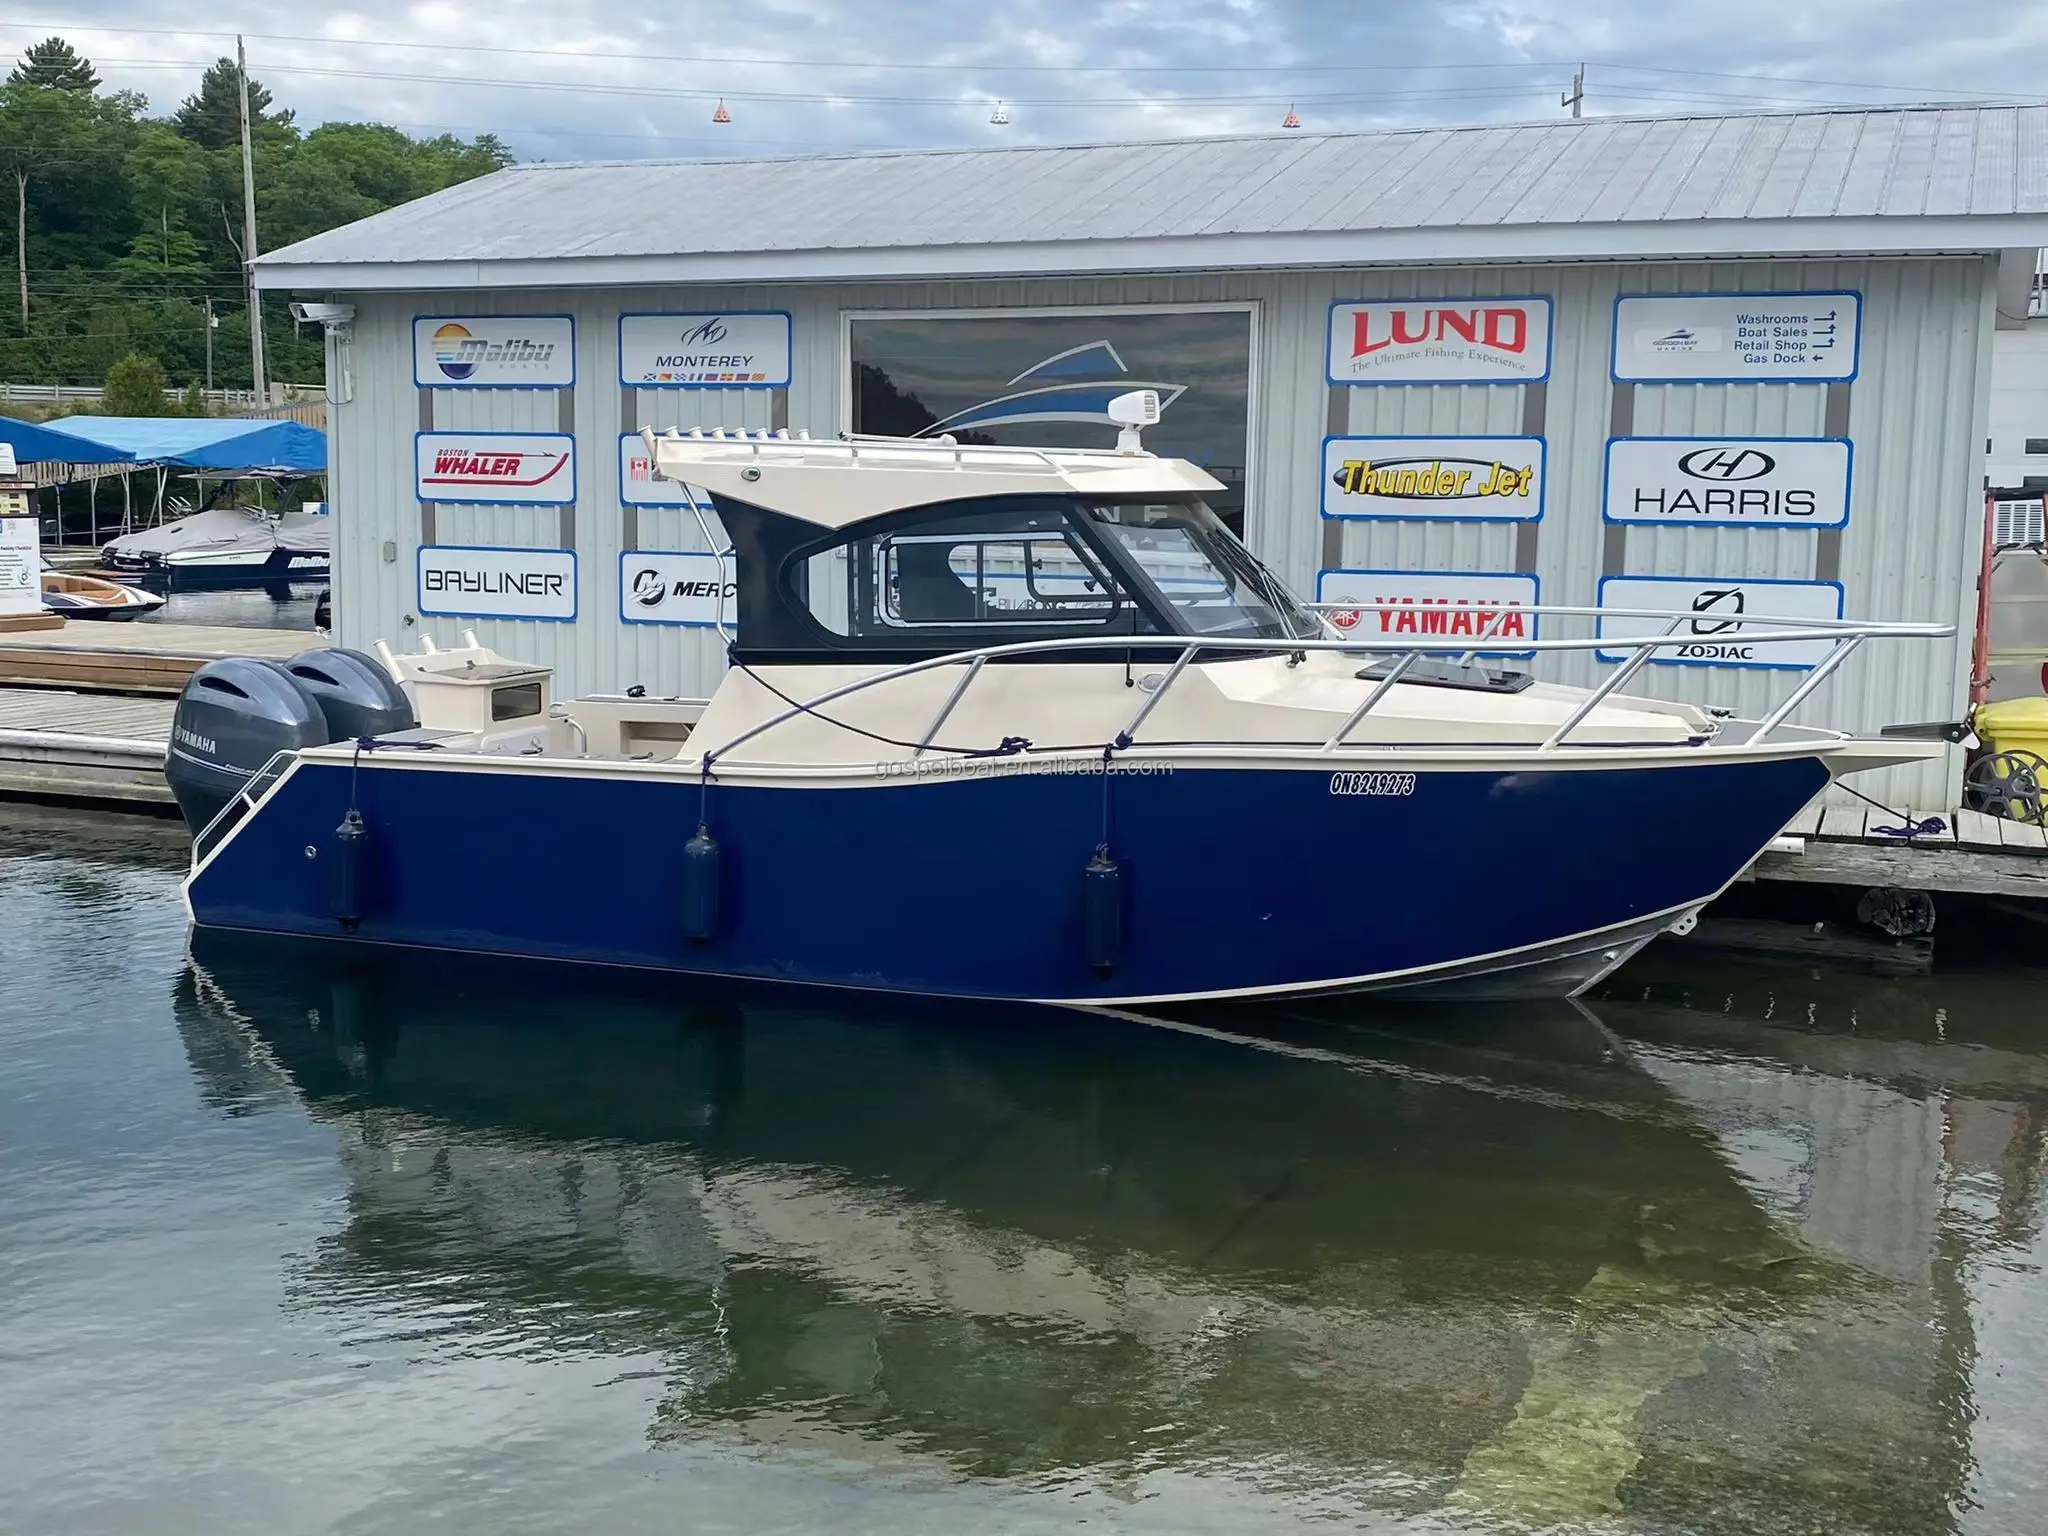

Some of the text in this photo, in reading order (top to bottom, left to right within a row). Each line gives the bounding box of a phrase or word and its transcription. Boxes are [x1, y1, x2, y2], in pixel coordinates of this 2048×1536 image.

[1736, 314, 1808, 325] Washrooms
[1351, 308, 1527, 358] LUND
[1738, 327, 1808, 337] Boat Sales
[455, 339, 554, 361] Malibu
[1734, 340, 1807, 352] Retail Shop
[656, 355, 754, 367] MONTEREY
[1350, 347, 1526, 373] The Ultimate Fishing Experience
[1744, 353, 1806, 363] Gas Dock
[438, 449, 469, 457] BOSTON
[434, 457, 521, 475] WHALER
[1343, 460, 1533, 497] Thunder Jet
[1634, 488, 1816, 516] HARRIS
[425, 570, 562, 596] BAYLINER
[1677, 645, 1754, 660] ZODIAC
[180, 728, 216, 754] YAMAHA
[1329, 772, 1416, 796] ON8249273
